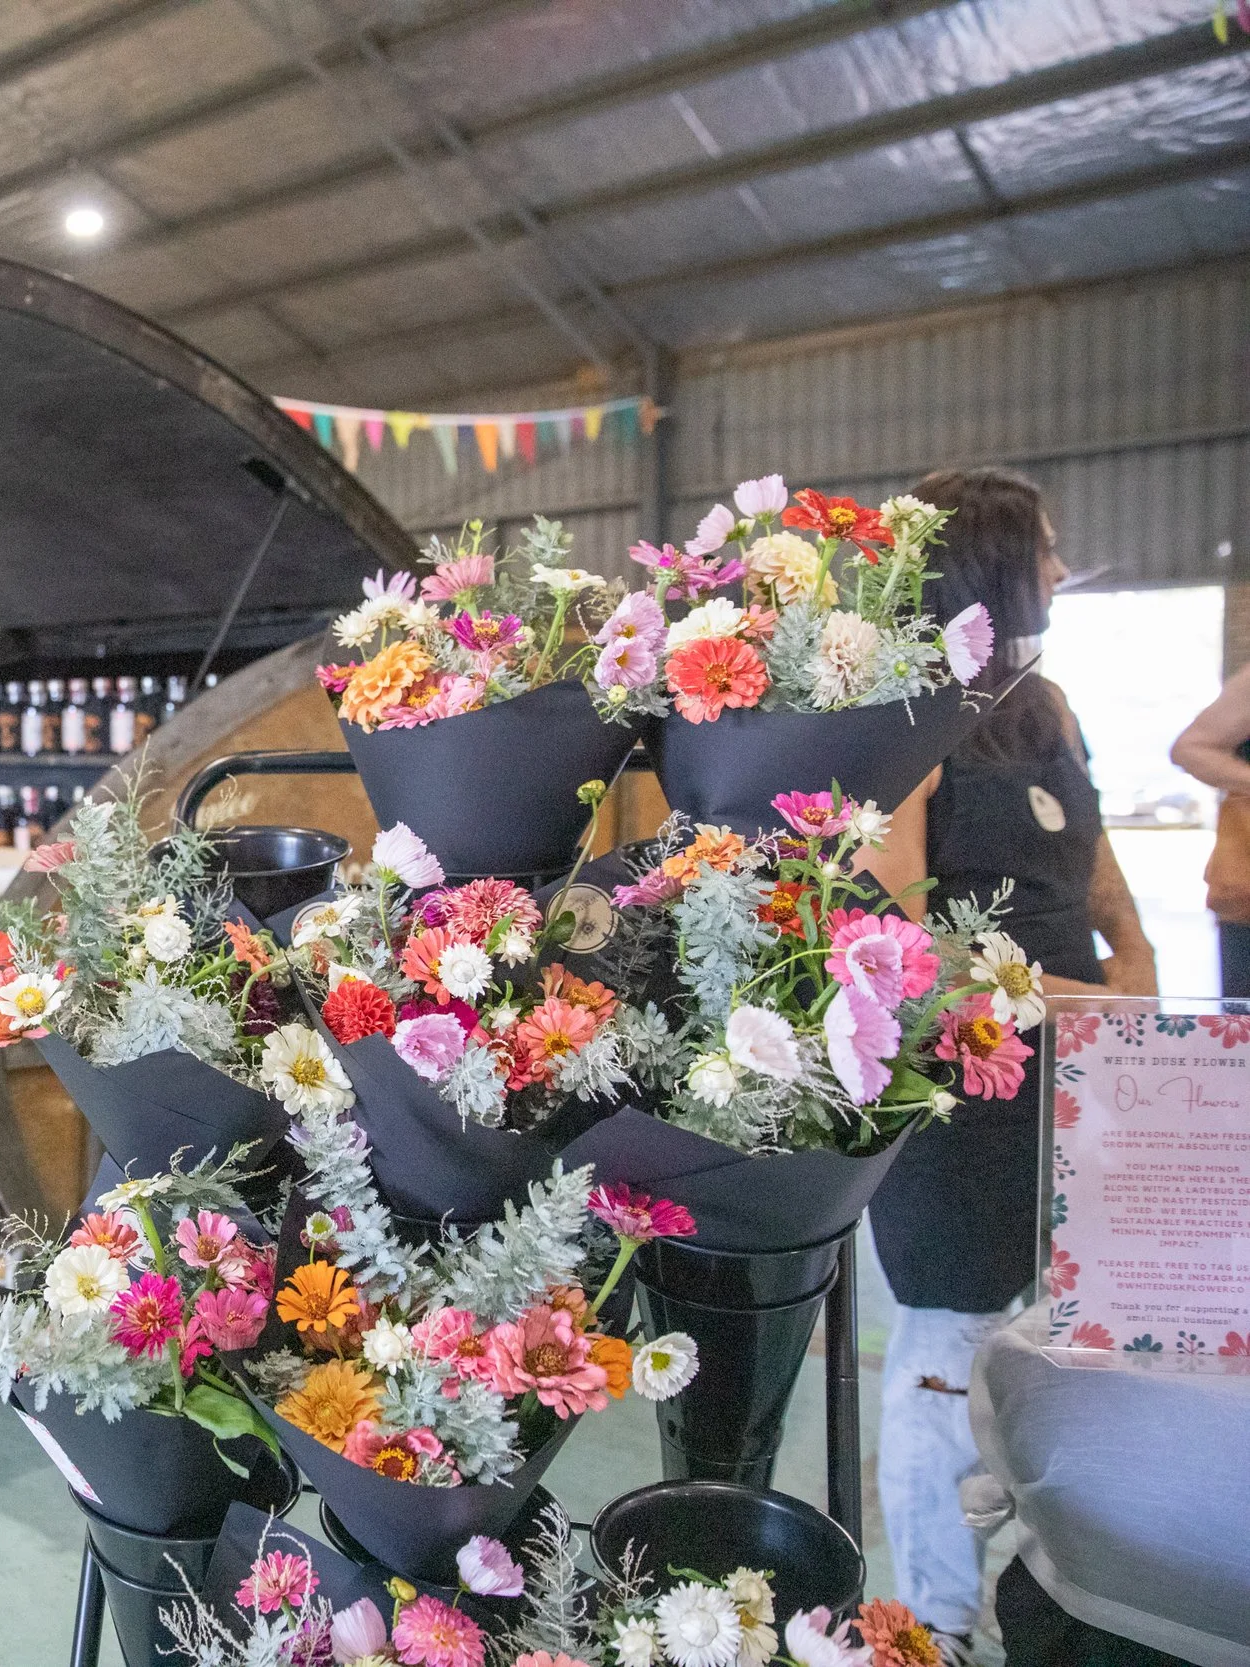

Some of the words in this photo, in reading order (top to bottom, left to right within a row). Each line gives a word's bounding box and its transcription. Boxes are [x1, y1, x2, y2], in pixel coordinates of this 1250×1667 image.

[1102, 1056, 1146, 1065] WHITE
[1152, 1057, 1186, 1066] DUSK
[1193, 1058, 1246, 1067] FLOWER
[1115, 1074, 1153, 1112] Our
[1158, 1076, 1240, 1113] Flowers
[1189, 1132, 1218, 1140] FARM
[1178, 1143, 1230, 1151] ABSOLUTE
[1177, 1164, 1202, 1172] FIND
[1205, 1165, 1240, 1173] MINOR
[1103, 1173, 1185, 1182] IMPERFECTIONS
[1103, 1184, 1138, 1192] ALONG
[1142, 1185, 1170, 1193] WITH
[1186, 1187, 1234, 1195] LADYBUG
[1162, 1197, 1198, 1205] NASTY
[1201, 1198, 1250, 1206] PESTICID
[1180, 1208, 1222, 1216] BELIEVE
[1110, 1217, 1181, 1226] SUSTAINABLE
[1184, 1219, 1243, 1228] PRACTICES
[1112, 1228, 1158, 1236] MINIMAL
[1159, 1240, 1203, 1249] IMPACT.
[1097, 1259, 1135, 1268] PLEASE
[1211, 1263, 1232, 1271] TAG
[1236, 1264, 1249, 1272] US
[1109, 1271, 1164, 1279] FACEBOOK
[1116, 1282, 1245, 1293] @WHITEDUSKFLOWERCO
[1110, 1302, 1141, 1310] Thank
[1144, 1304, 1162, 1312] you
[1184, 1306, 1240, 1315] supporting
